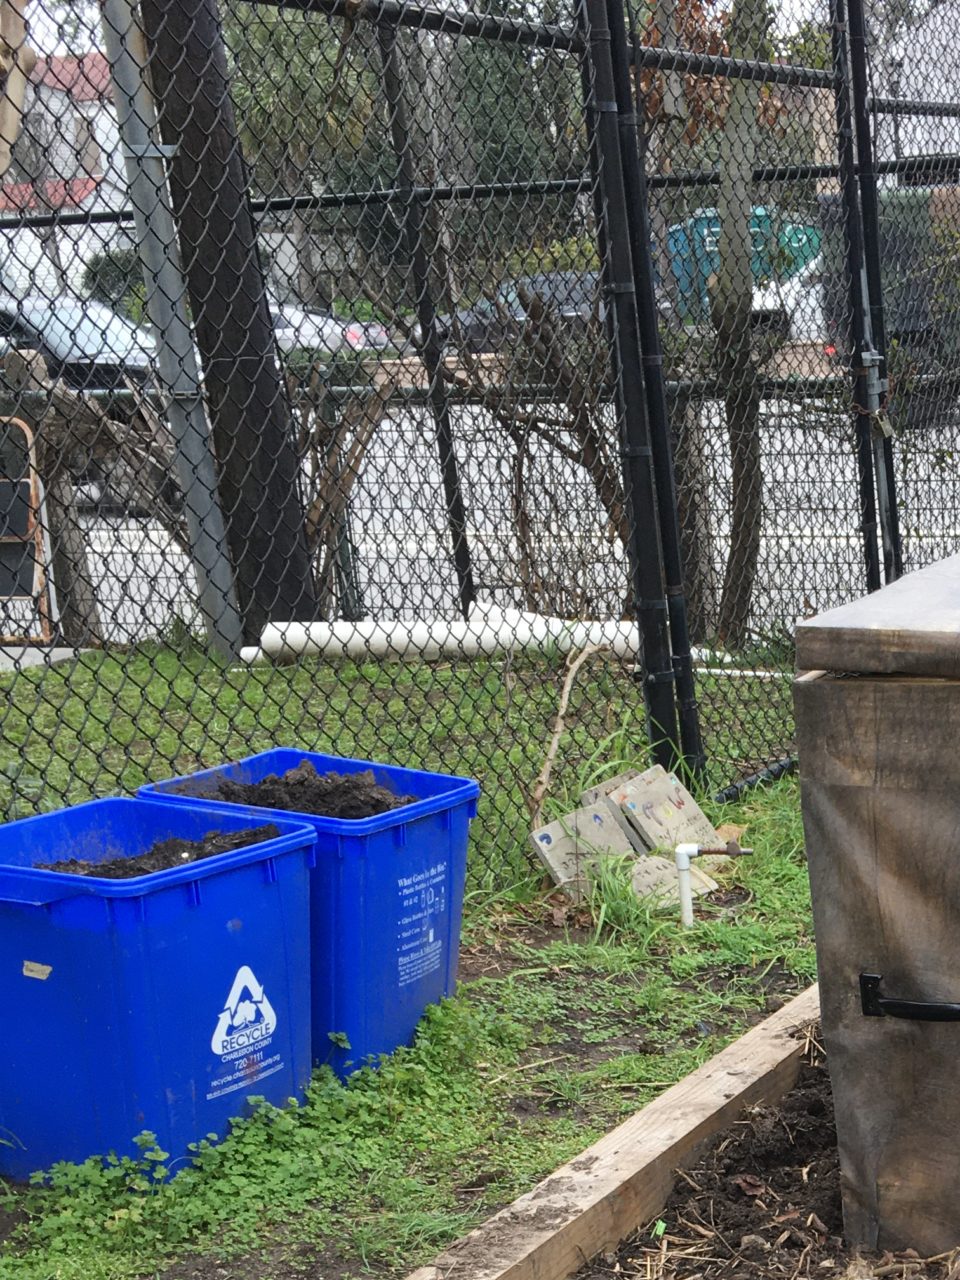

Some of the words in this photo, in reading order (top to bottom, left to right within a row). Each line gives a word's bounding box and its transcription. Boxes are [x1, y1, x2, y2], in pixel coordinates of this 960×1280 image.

[221, 1022, 271, 1052] RECYCLE
[221, 1045, 254, 1063] CHARLESTON
[254, 1037, 273, 1052] COUNTY
[233, 1051, 264, 1070] 7207111
